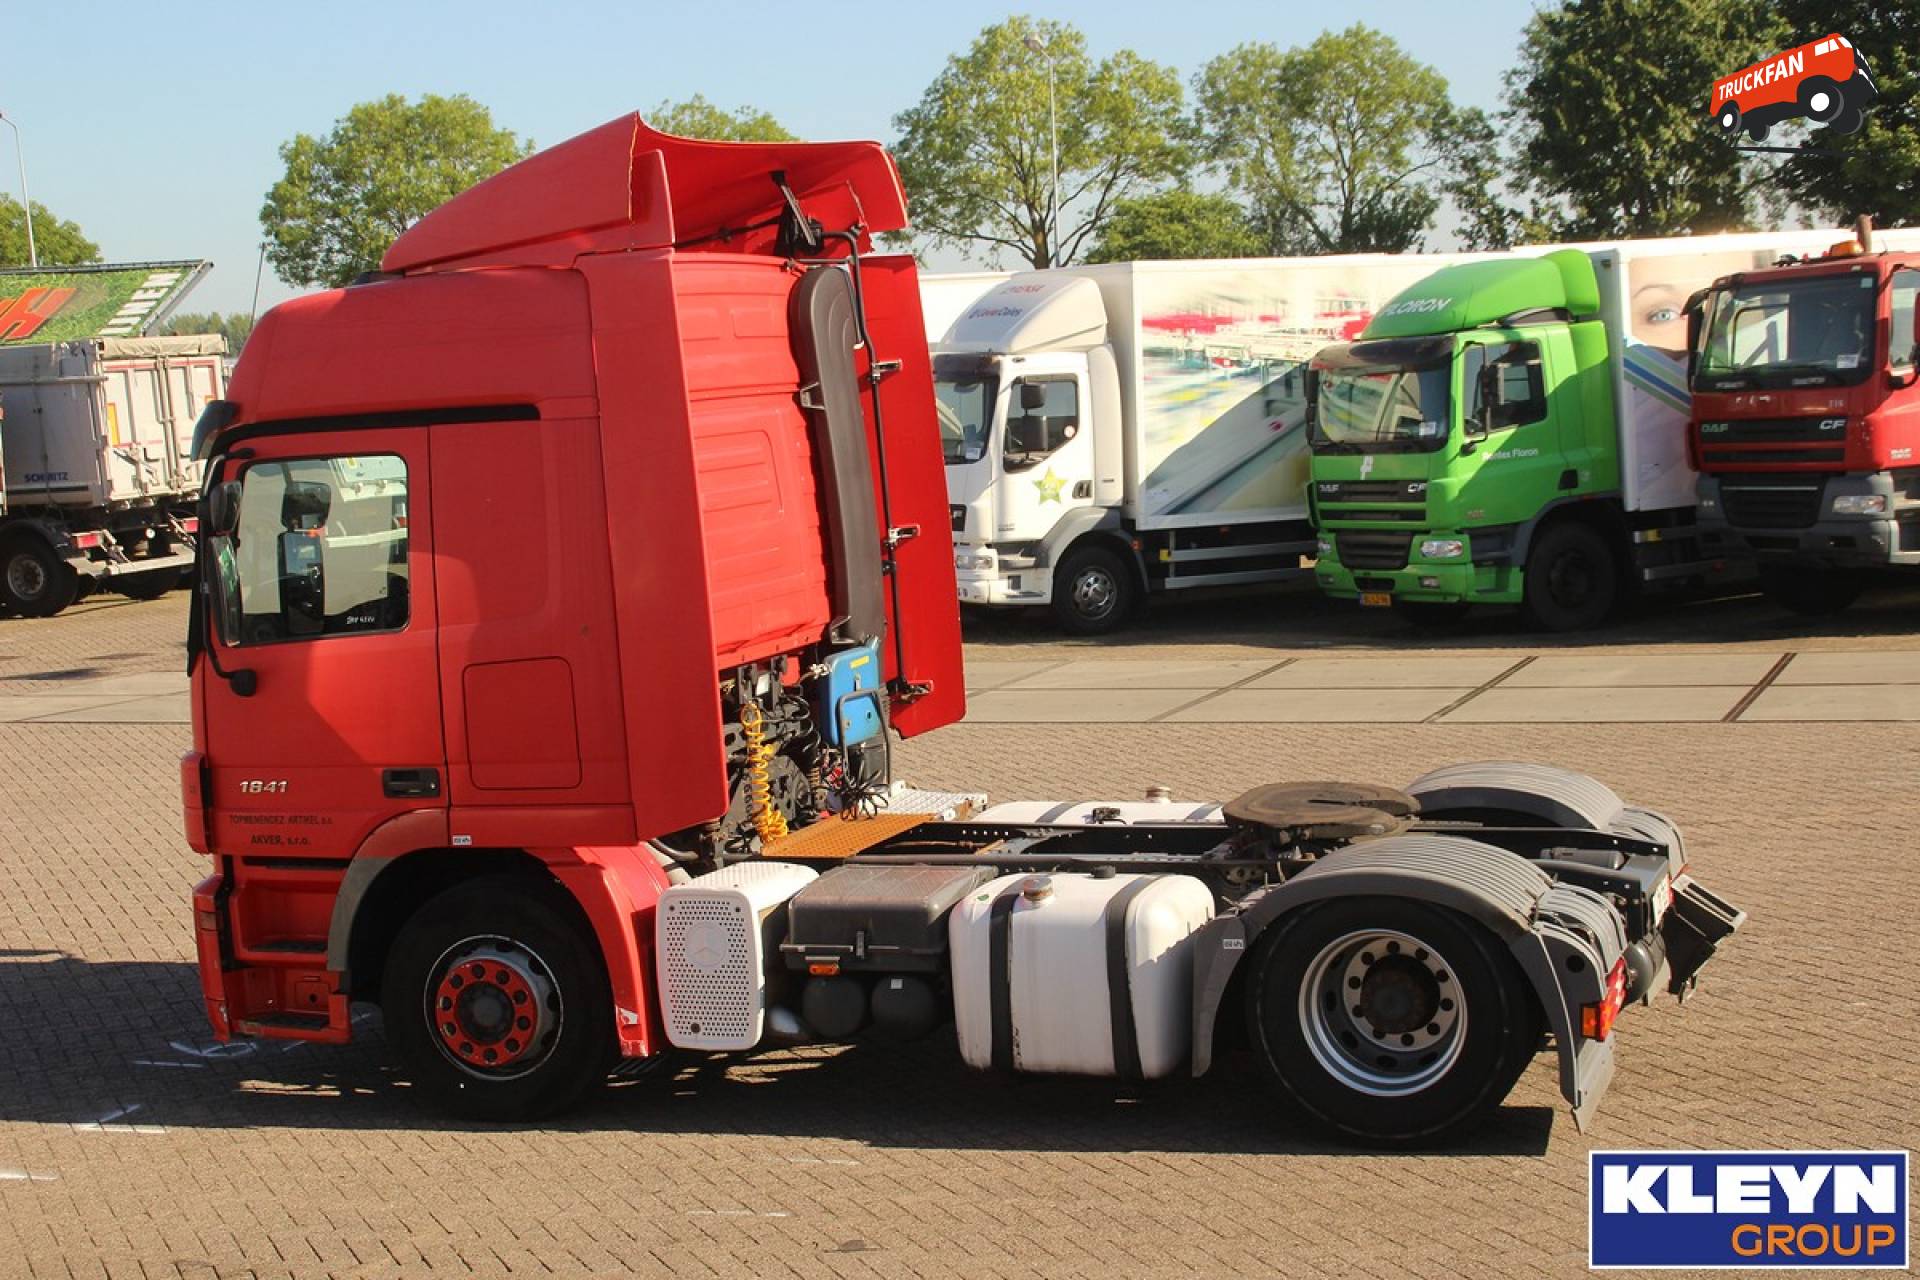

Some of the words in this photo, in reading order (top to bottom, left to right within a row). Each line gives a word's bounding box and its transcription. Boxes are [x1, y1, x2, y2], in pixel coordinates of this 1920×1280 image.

[1819, 419, 1846, 430] CF
[1407, 482, 1428, 493] CF
[240, 780, 288, 793] 1841
